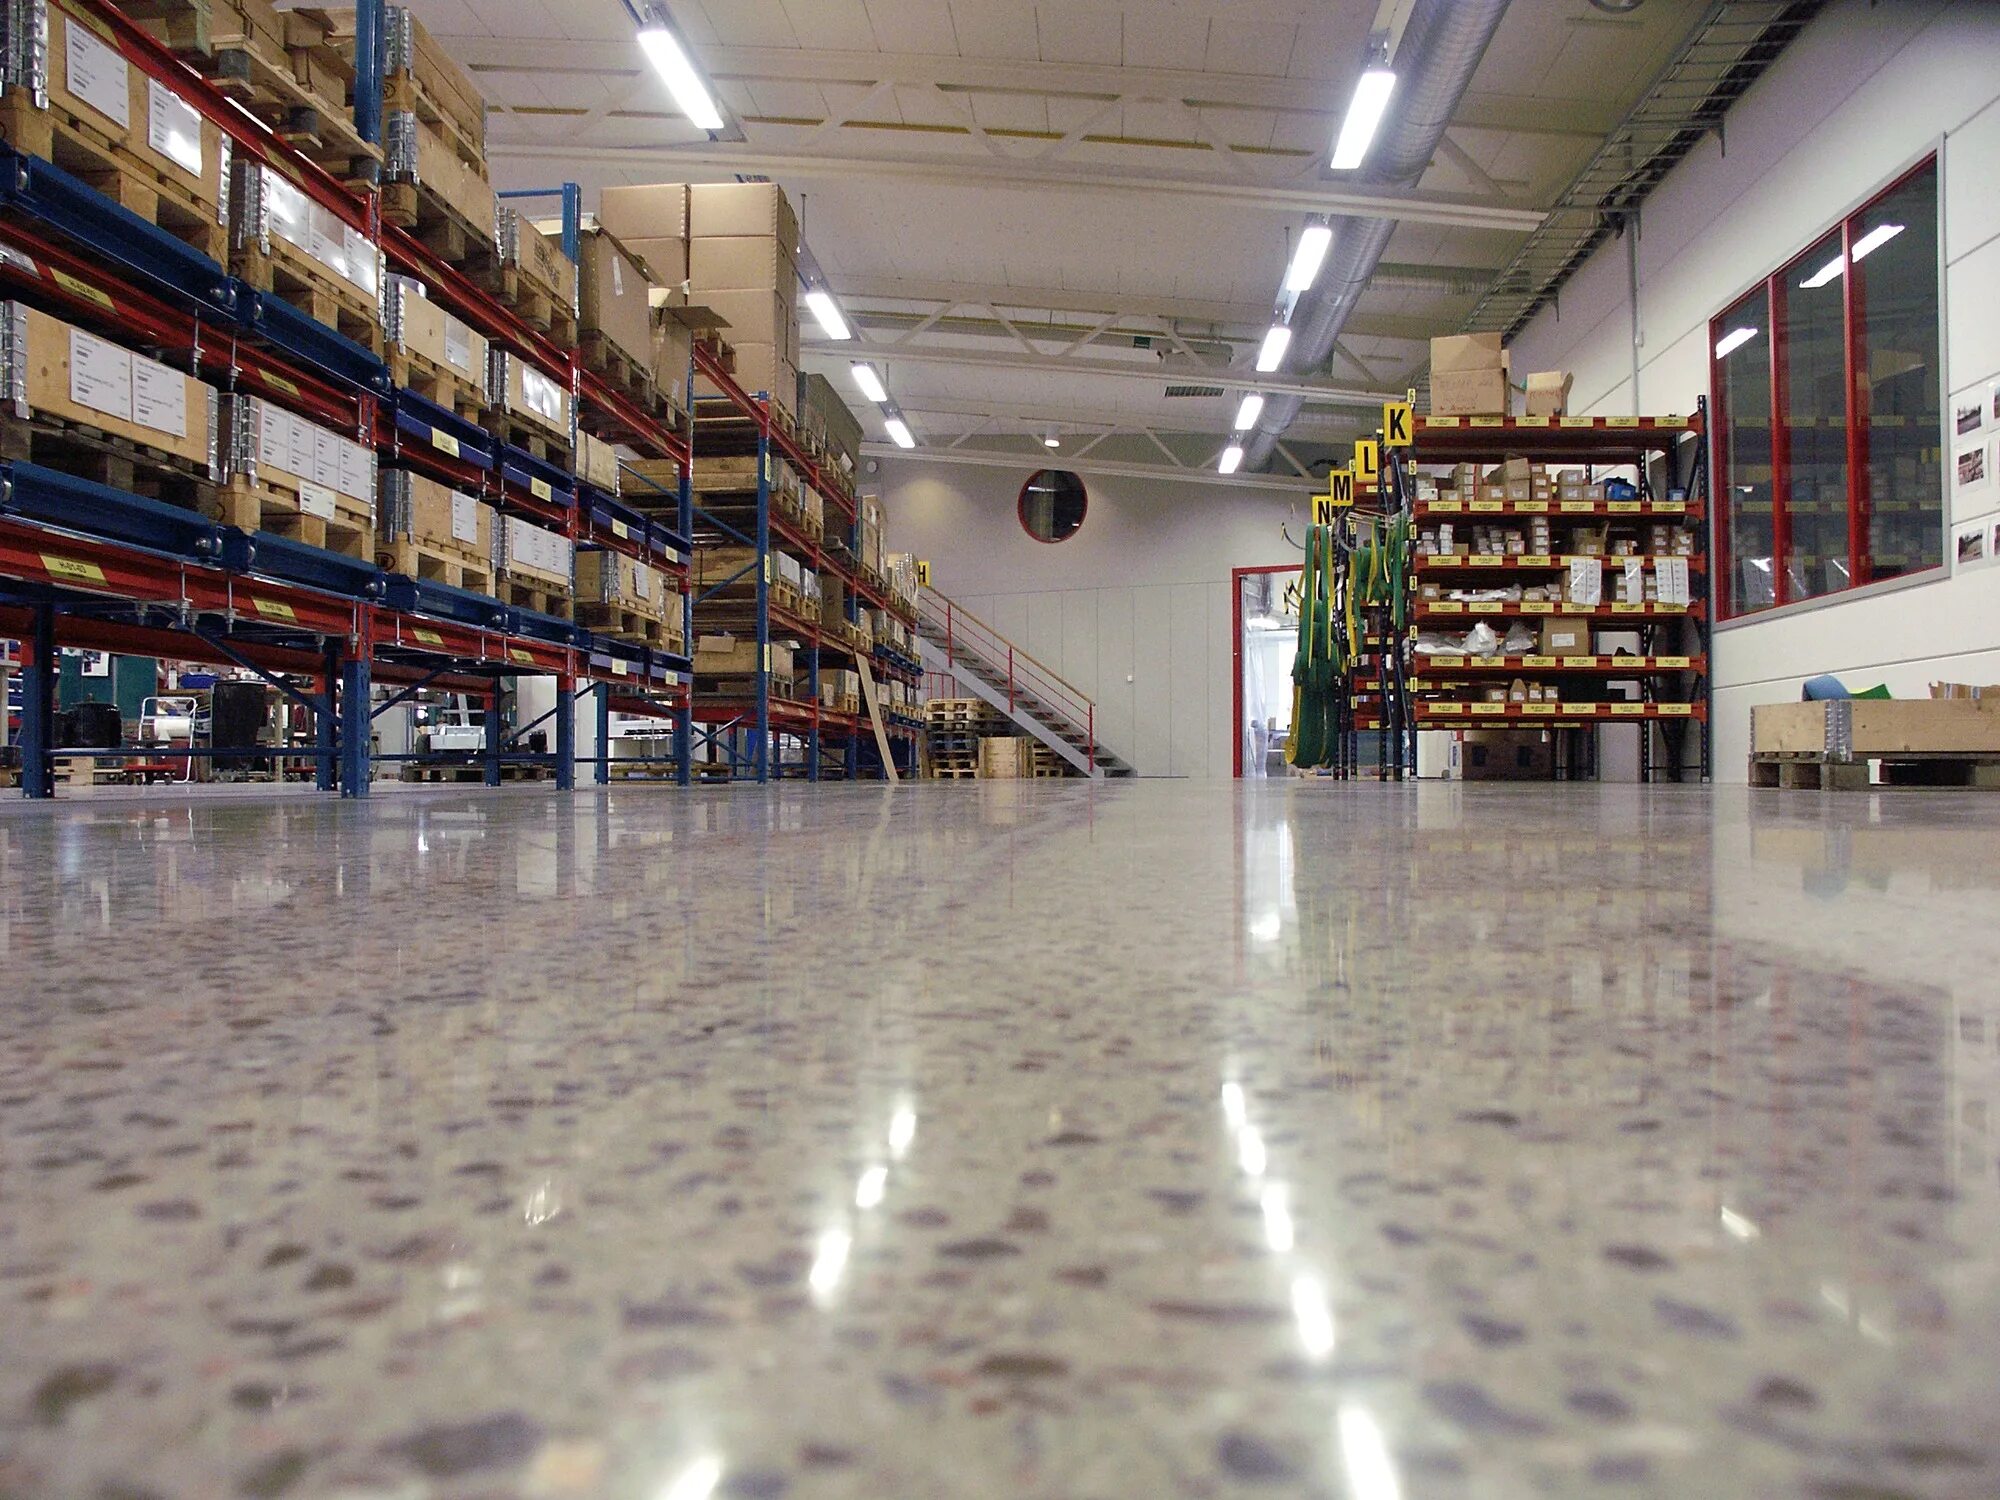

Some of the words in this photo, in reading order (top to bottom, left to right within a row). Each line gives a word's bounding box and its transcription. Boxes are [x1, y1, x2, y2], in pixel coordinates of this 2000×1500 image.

[1389, 408, 1407, 440] K
[1363, 446, 1376, 474] L
[1333, 475, 1351, 501] M
[1317, 500, 1331, 524] N
[918, 564, 926, 583] H
[1411, 627, 1417, 640] 2
